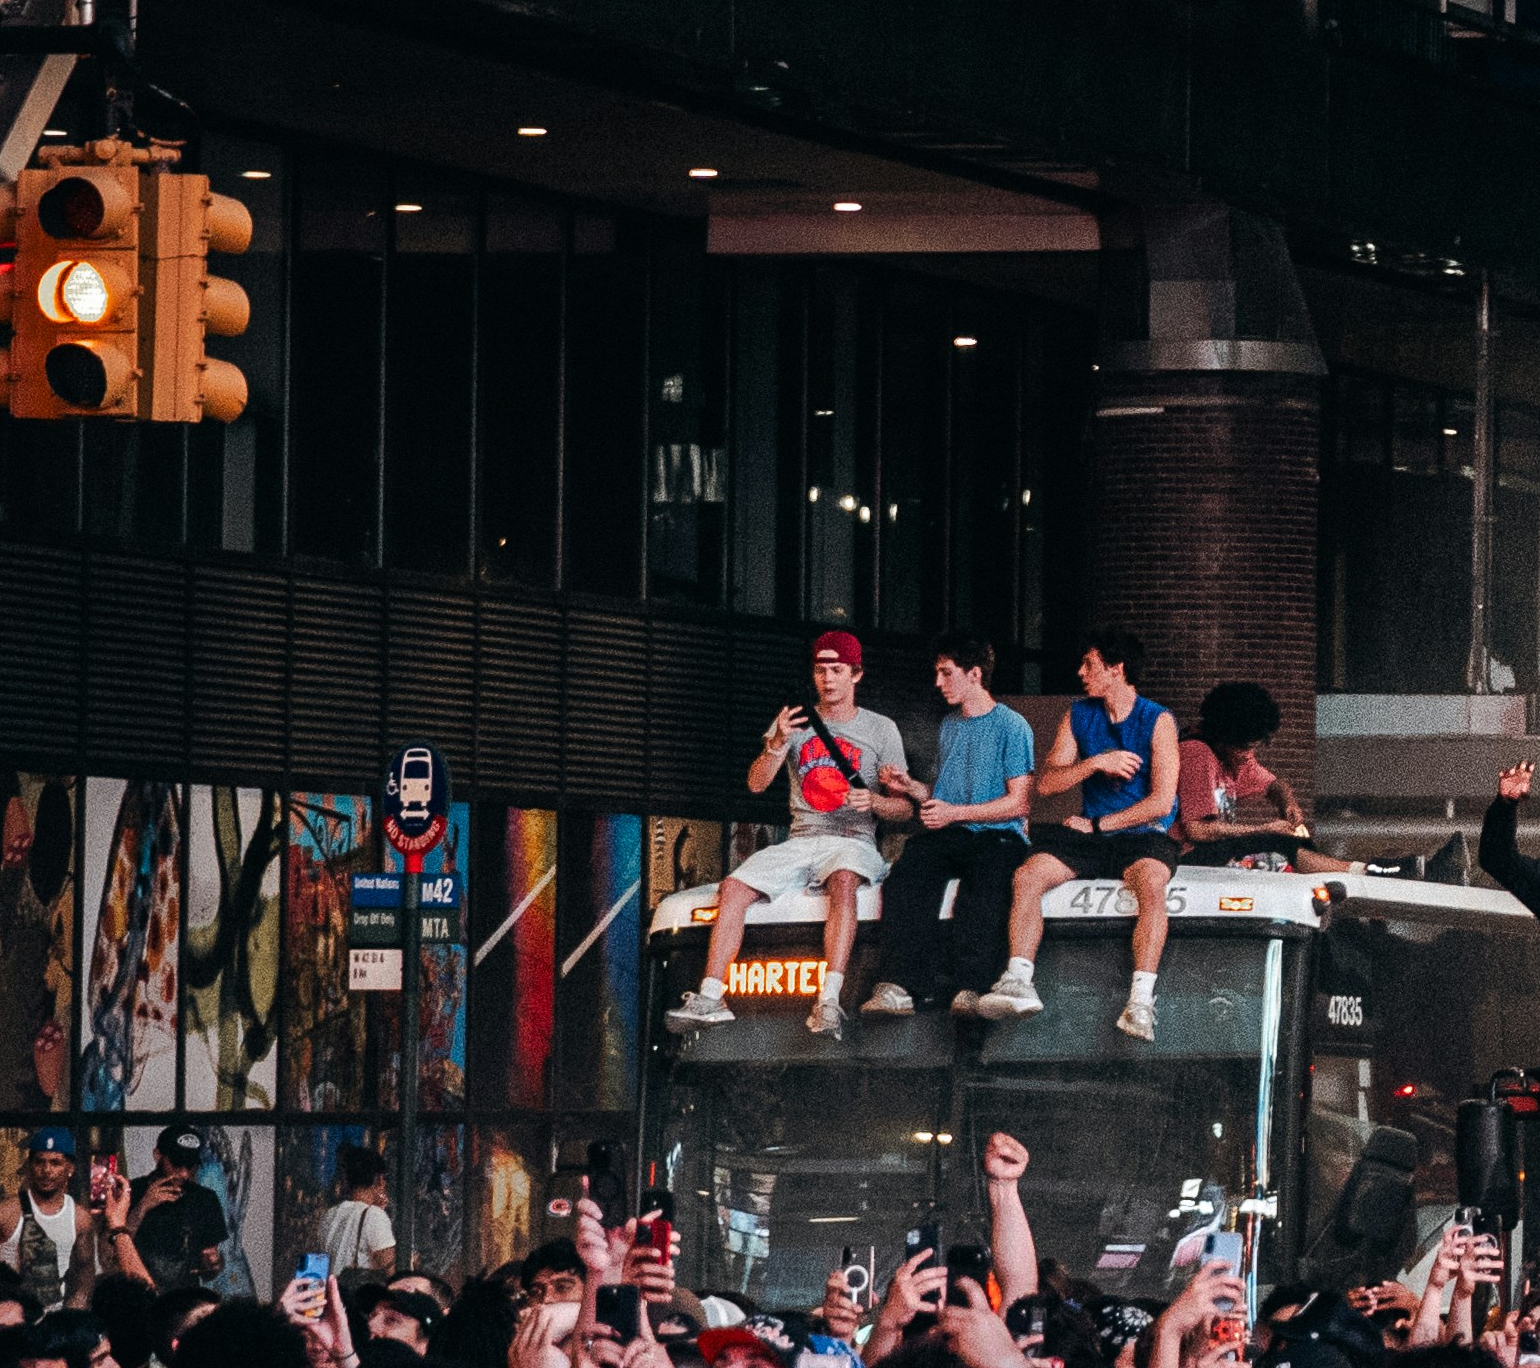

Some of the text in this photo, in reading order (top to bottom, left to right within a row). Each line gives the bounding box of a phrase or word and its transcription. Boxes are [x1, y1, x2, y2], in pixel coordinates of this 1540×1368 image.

[422, 878, 453, 903] M42
[1070, 886, 1188, 915] 4785
[421, 918, 450, 939] MTA
[722, 962, 827, 993] HARTE
[1328, 995, 1363, 1026] 47835
